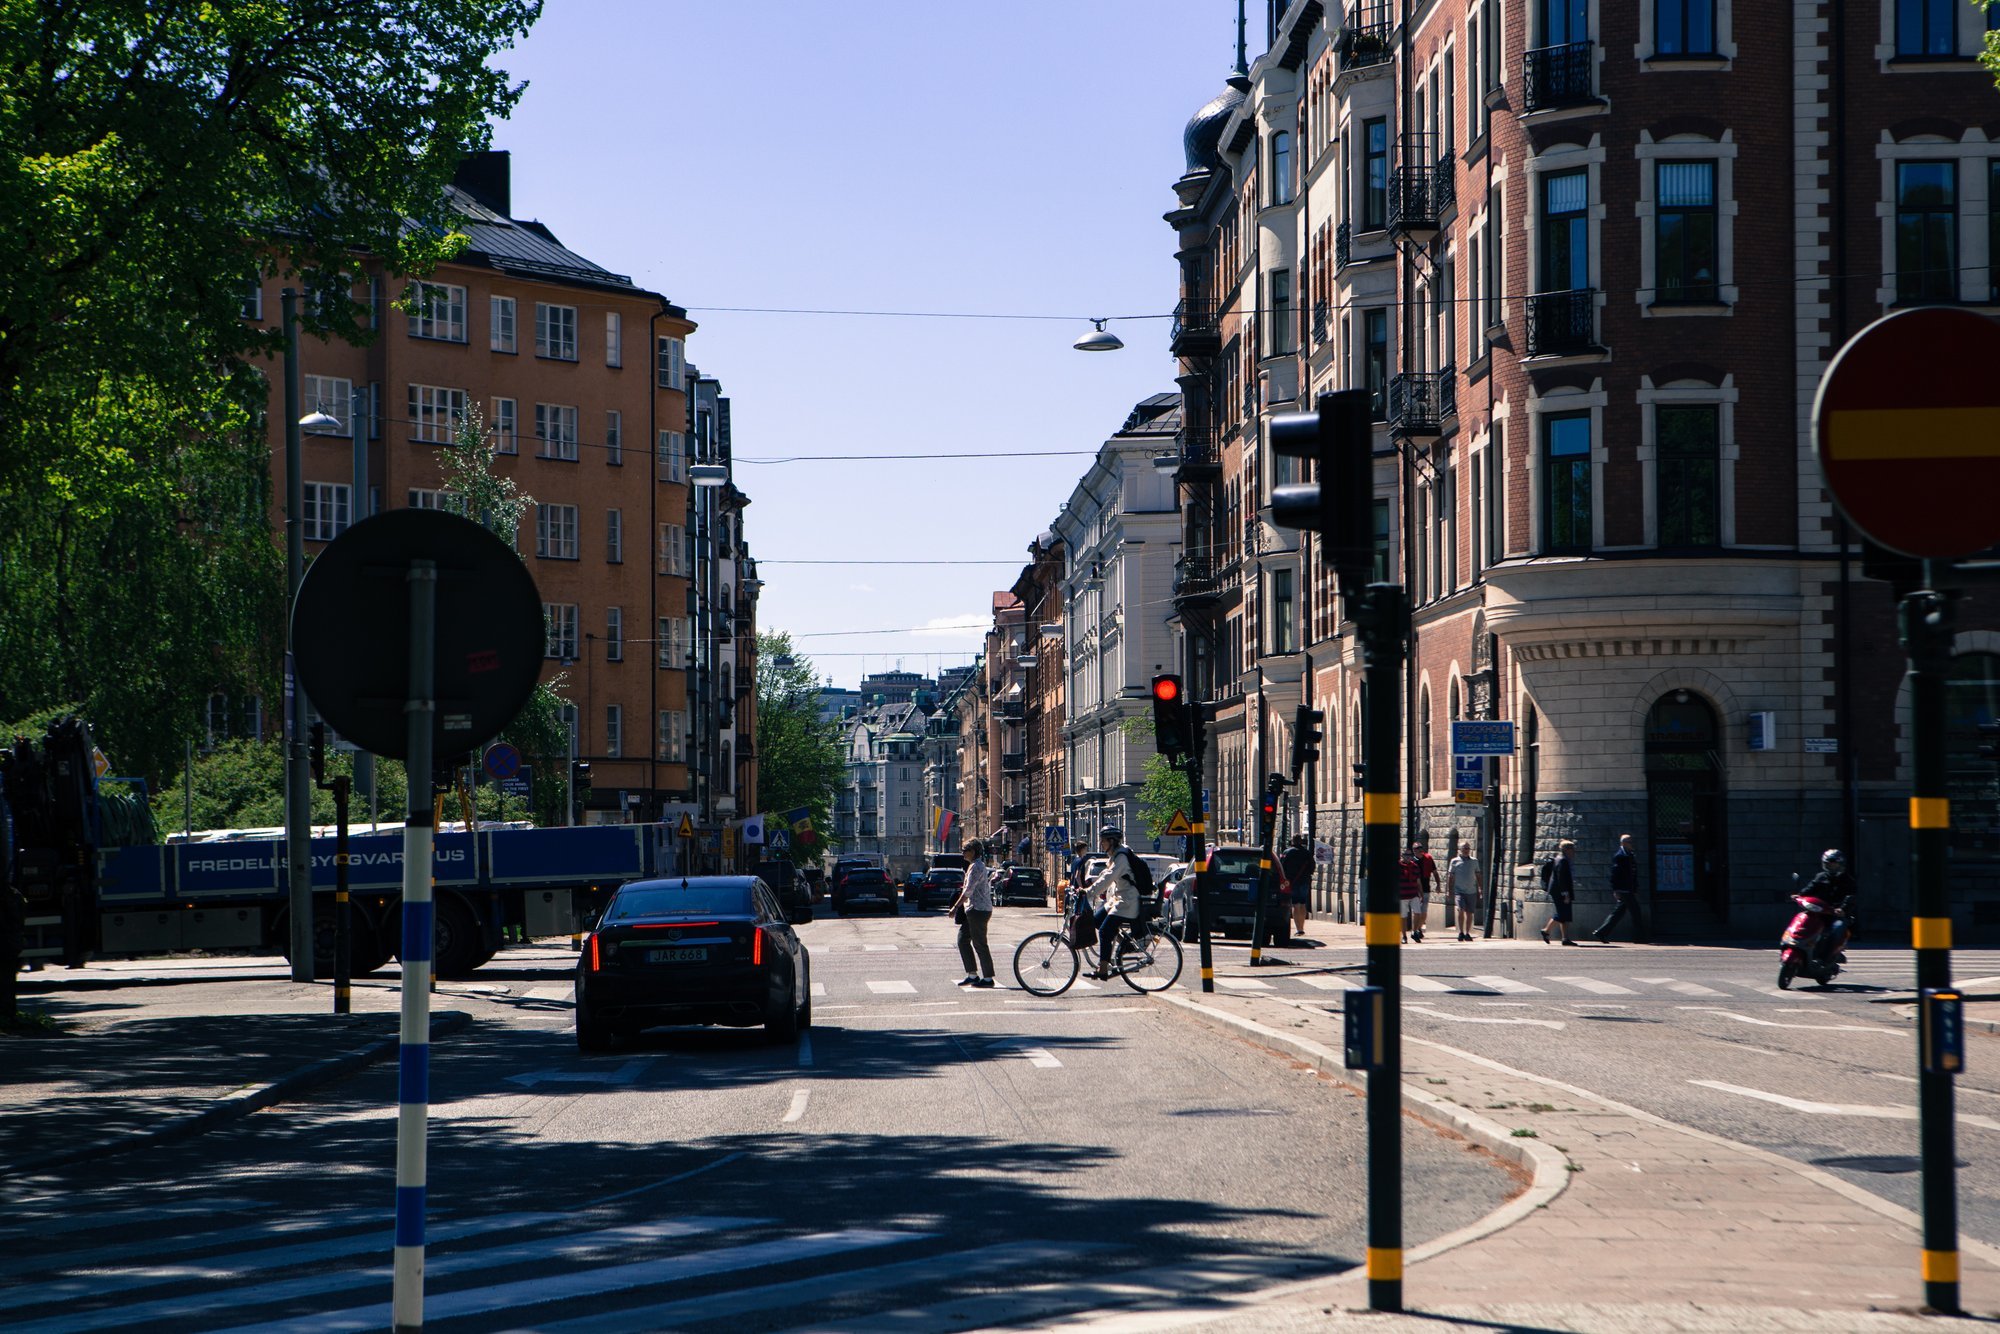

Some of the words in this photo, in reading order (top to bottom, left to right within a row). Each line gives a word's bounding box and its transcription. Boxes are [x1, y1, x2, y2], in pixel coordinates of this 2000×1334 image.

[1457, 725, 1509, 734] STOCKHOLM
[188, 857, 292, 873] FREDELLS
[654, 951, 677, 962] JAR
[679, 950, 703, 961] 668
